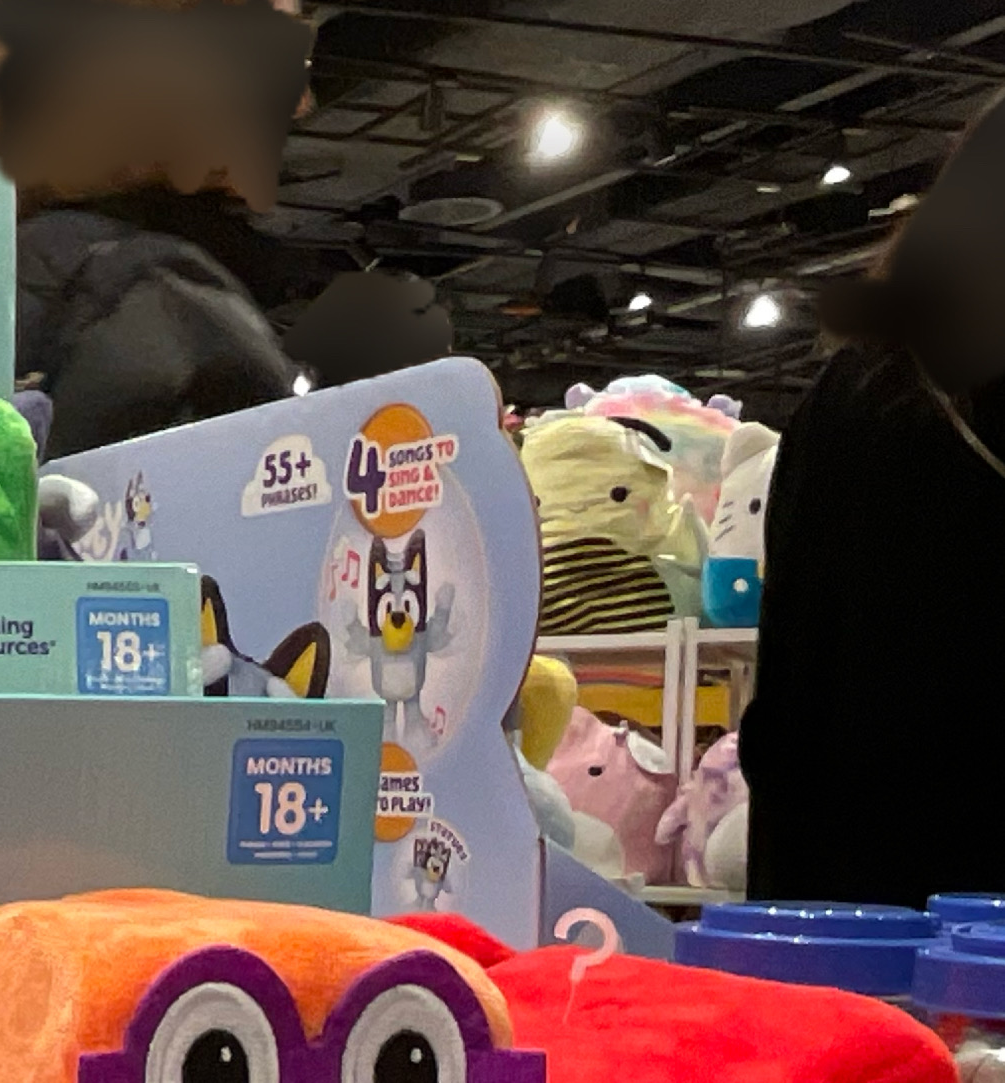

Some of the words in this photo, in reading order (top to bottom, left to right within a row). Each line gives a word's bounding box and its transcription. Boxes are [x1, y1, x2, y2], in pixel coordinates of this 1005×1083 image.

[437, 440, 455, 459] TO
[263, 450, 312, 488] 55+
[347, 440, 386, 513] 4
[89, 612, 160, 627] MONTHS
[97, 630, 165, 673] 18+
[246, 756, 333, 776] MONTHS
[254, 782, 329, 835] 18+
